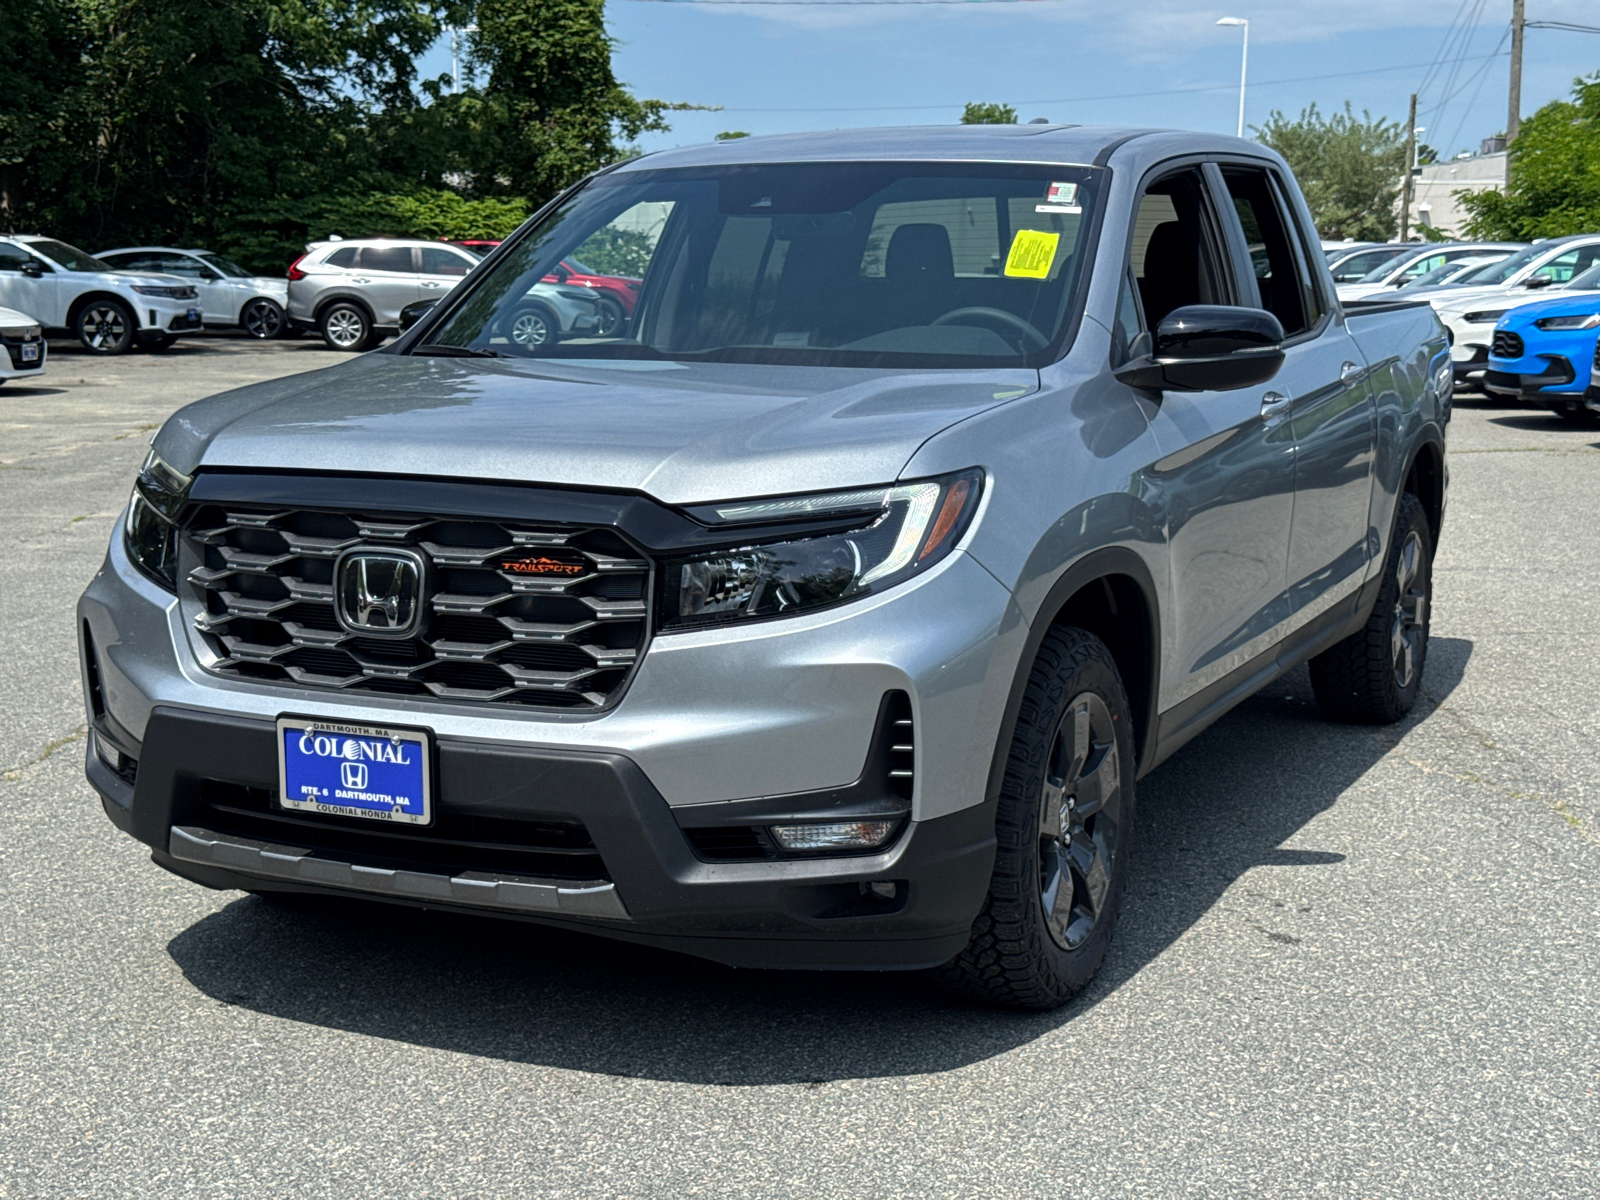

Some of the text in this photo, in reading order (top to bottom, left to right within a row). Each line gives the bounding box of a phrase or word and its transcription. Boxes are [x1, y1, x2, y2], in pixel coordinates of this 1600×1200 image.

[501, 563, 583, 574] TRAILSPORT
[375, 729, 390, 737] MA
[299, 735, 410, 765] COLONIAL
[301, 785, 410, 806] RTE. 6 DARTMOUTH, MA
[316, 804, 393, 820] COLONIAL HONDA
